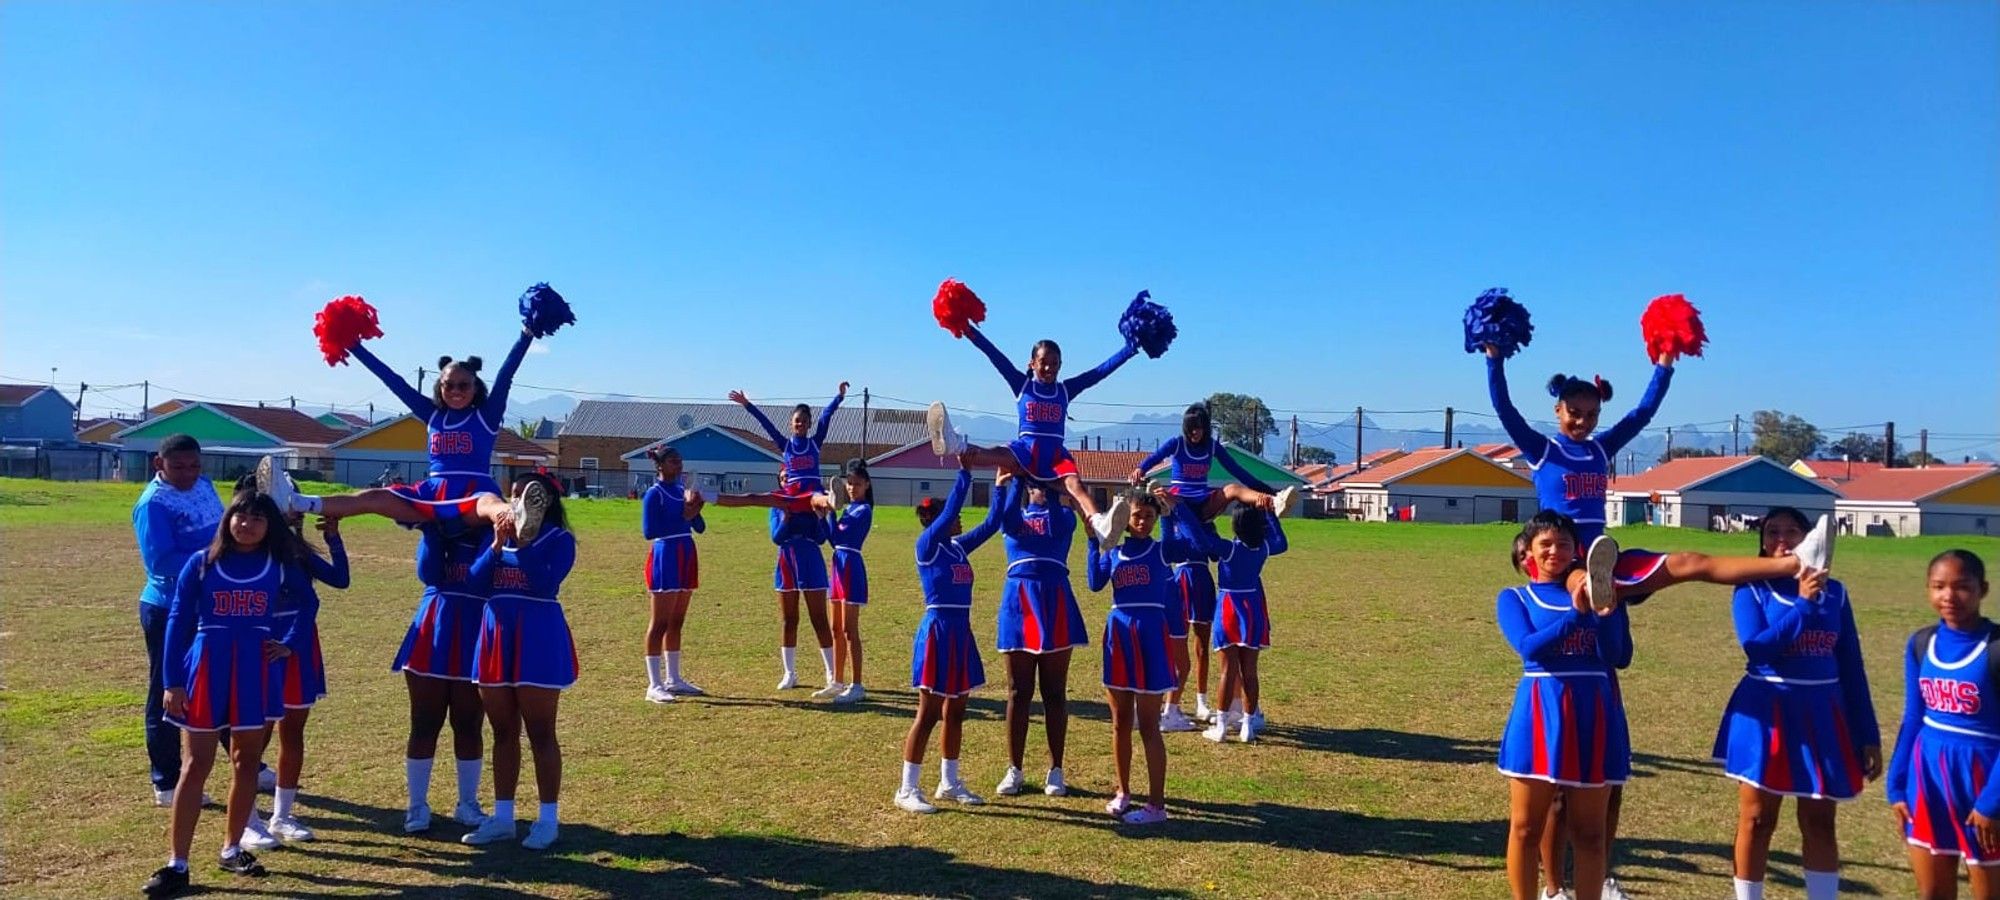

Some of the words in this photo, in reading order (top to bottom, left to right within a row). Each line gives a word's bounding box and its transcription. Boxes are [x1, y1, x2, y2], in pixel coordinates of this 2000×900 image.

[431, 433, 473, 454] DHS
[951, 564, 975, 585] DH
[213, 590, 267, 616] DHS
[1919, 678, 1981, 716] DHS
